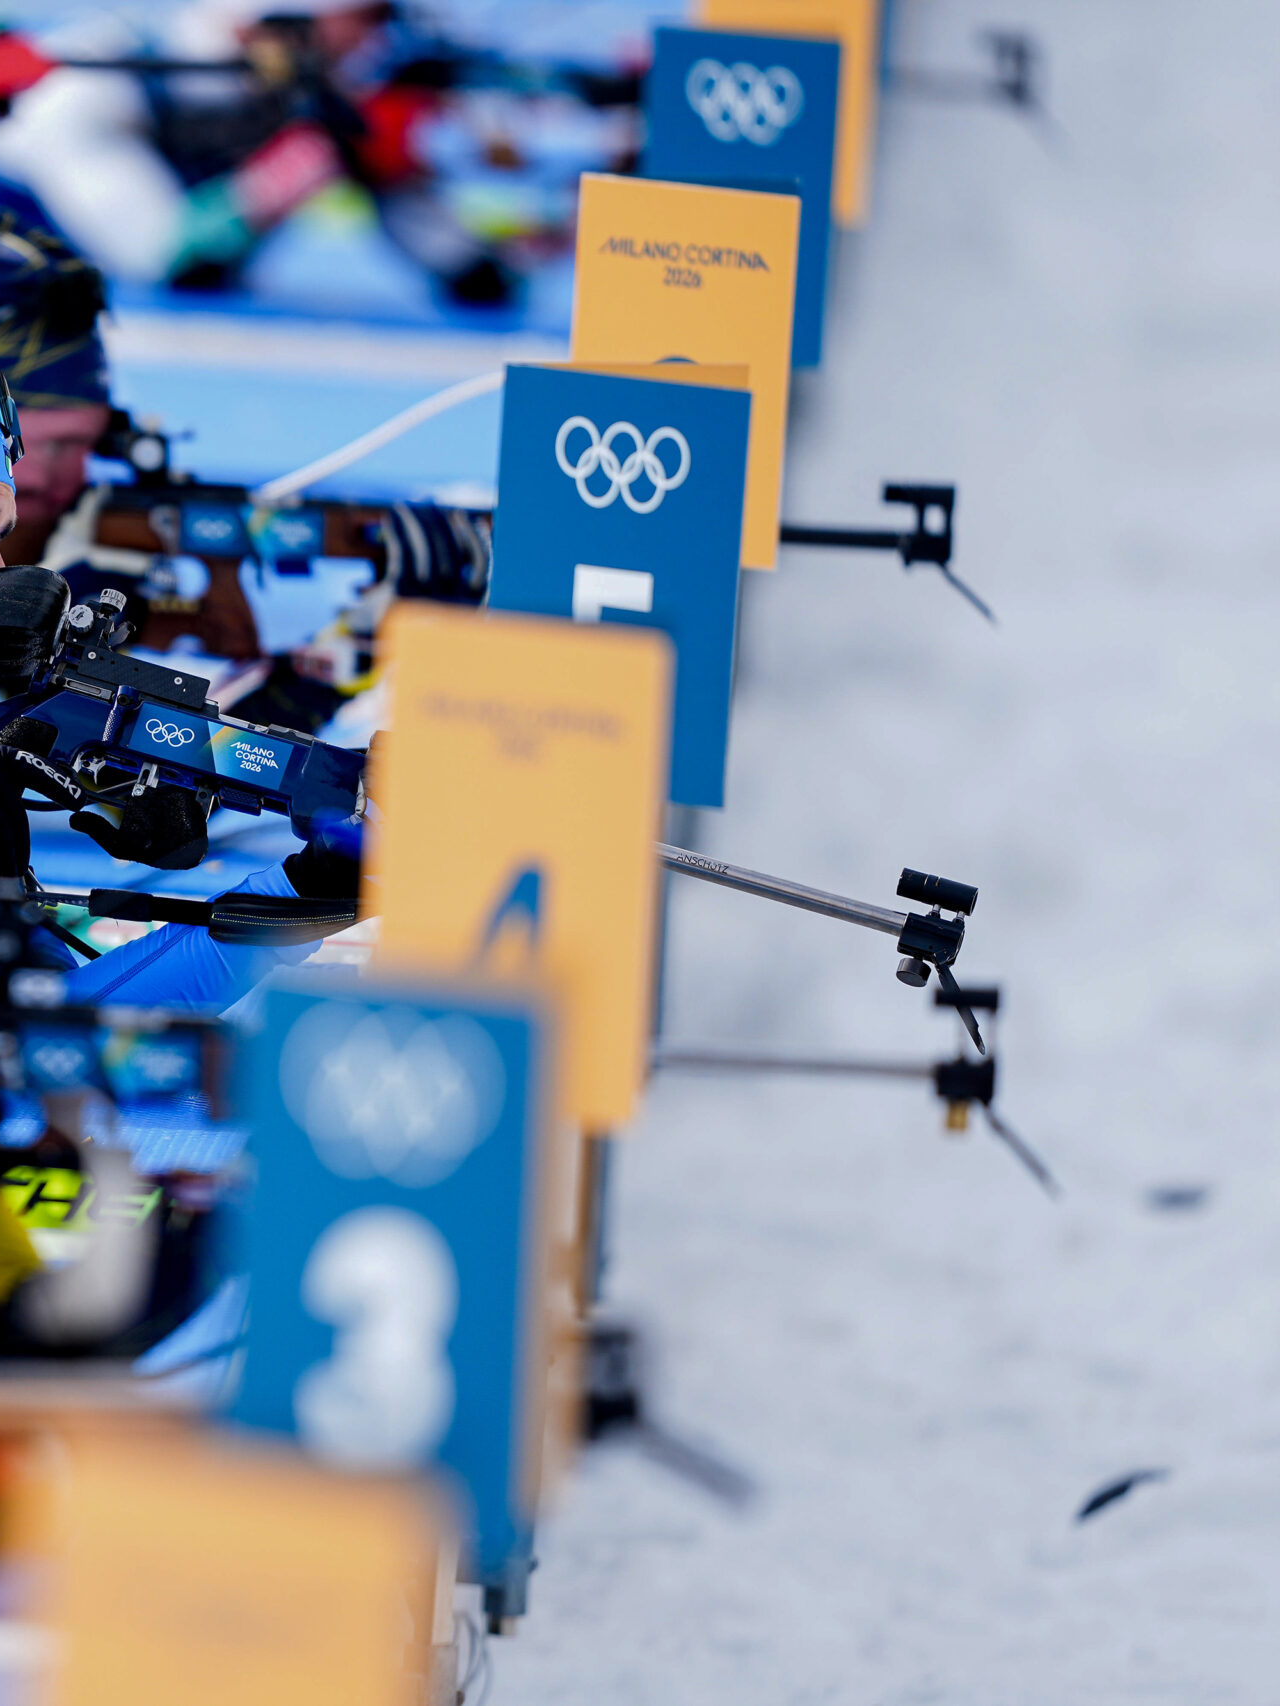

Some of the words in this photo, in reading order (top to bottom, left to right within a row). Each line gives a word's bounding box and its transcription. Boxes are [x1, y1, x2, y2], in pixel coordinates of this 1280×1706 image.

[599, 235, 682, 262] MILANO
[684, 243, 771, 273] CORTINA
[663, 266, 703, 289] 2026
[230, 741, 275, 758] MILANO
[235, 750, 279, 769] CORTINA
[240, 760, 262, 773] 2026
[292, 1203, 460, 1472] 3
